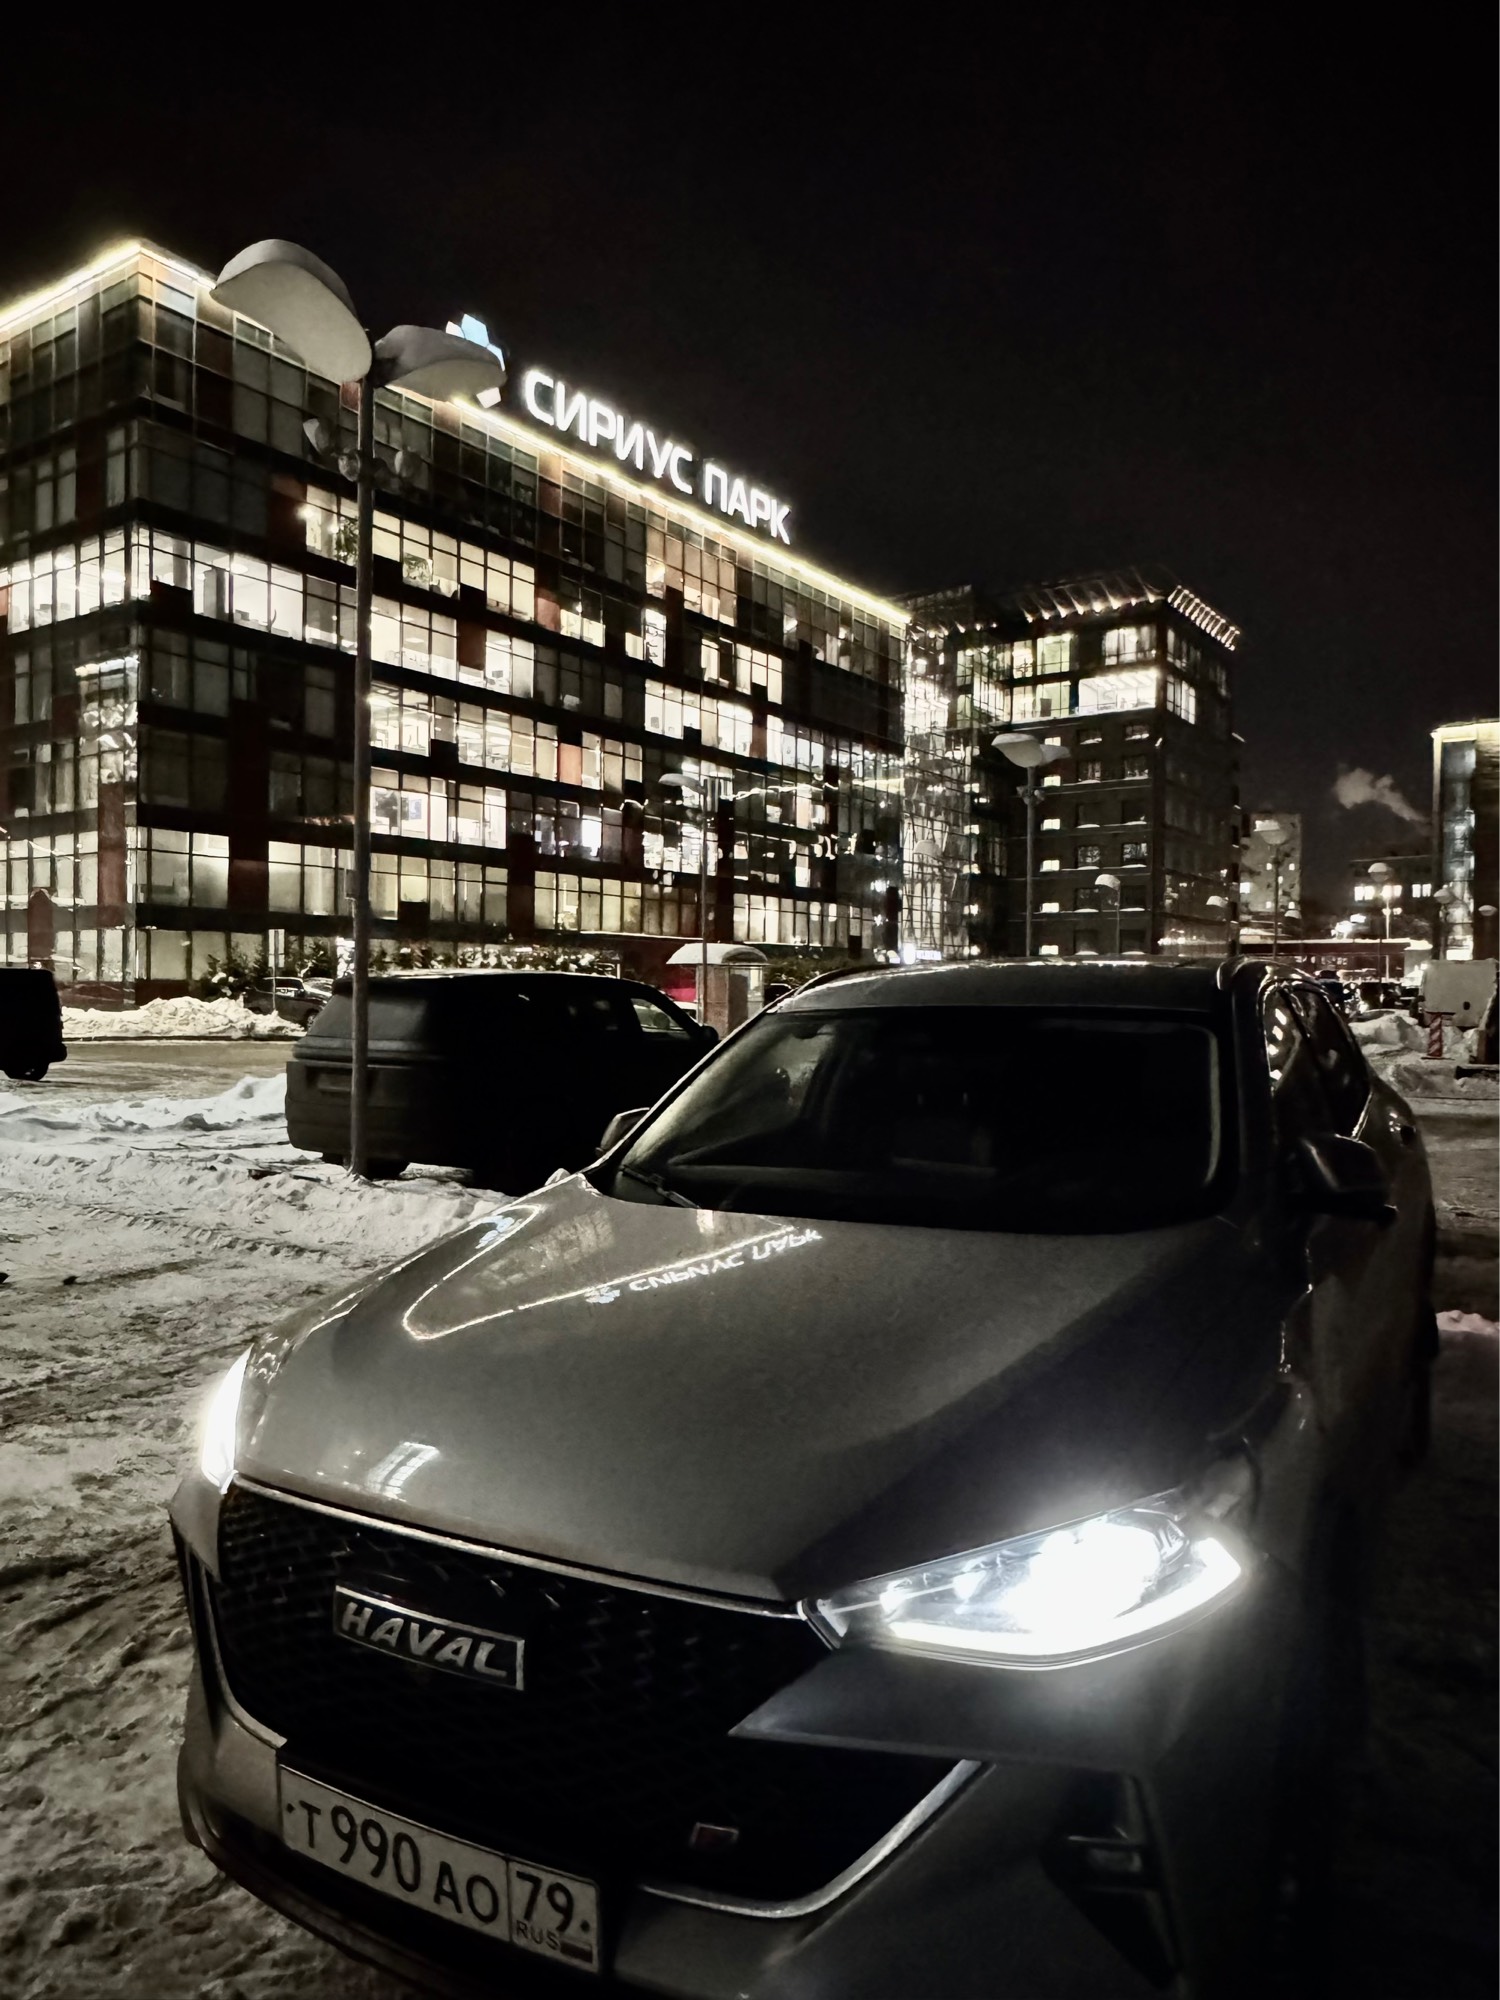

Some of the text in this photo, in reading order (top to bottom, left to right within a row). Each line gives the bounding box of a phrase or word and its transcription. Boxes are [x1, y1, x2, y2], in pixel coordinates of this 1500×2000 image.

[523, 370, 791, 545] СИРИУС ПАРК
[341, 1602, 507, 1678] HAVAL
[517, 1871, 574, 1933] 79
[517, 1921, 560, 1950] RUS
